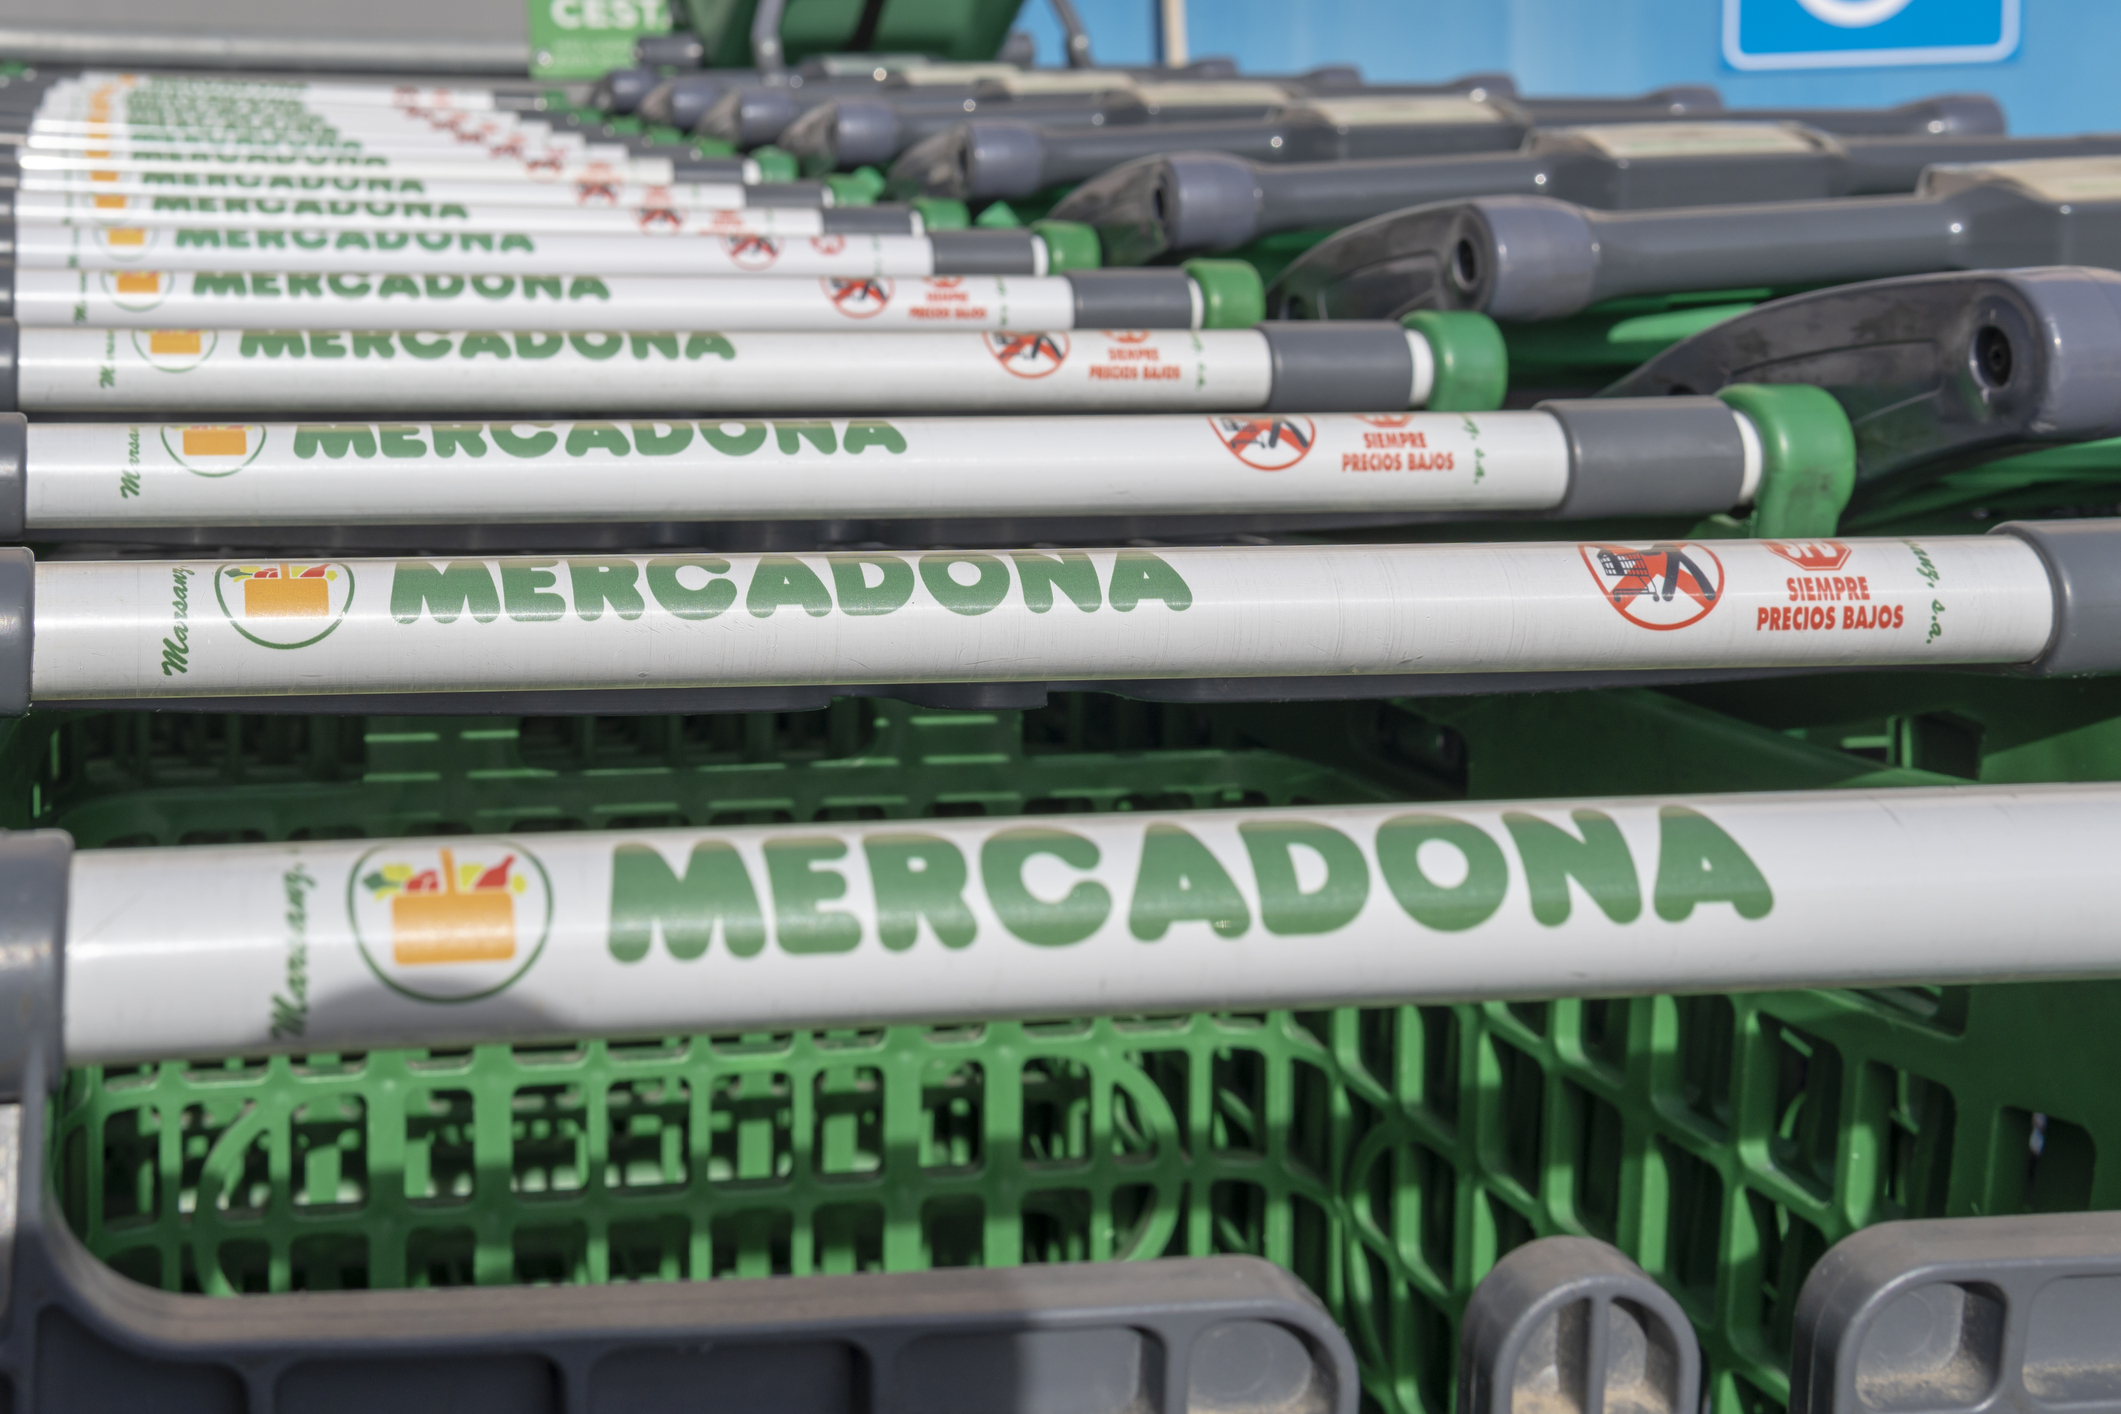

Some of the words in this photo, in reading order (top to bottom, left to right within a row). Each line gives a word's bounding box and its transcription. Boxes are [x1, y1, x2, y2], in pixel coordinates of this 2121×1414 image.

[192, 272, 610, 300] MERCADONA
[239, 330, 736, 360] MERCADONA
[293, 421, 907, 460] MERCADONA
[1363, 432, 1428, 449] SIEMPRE
[1342, 453, 1403, 472] PRECIOS
[1407, 452, 1455, 472] BAJOS
[390, 552, 1193, 624] MERCADONA
[1786, 576, 1871, 601] SIEMPRE
[1757, 606, 1836, 631] PRECIOS
[1842, 604, 1904, 630] BAJOS
[606, 805, 1774, 963] MERCADONA
